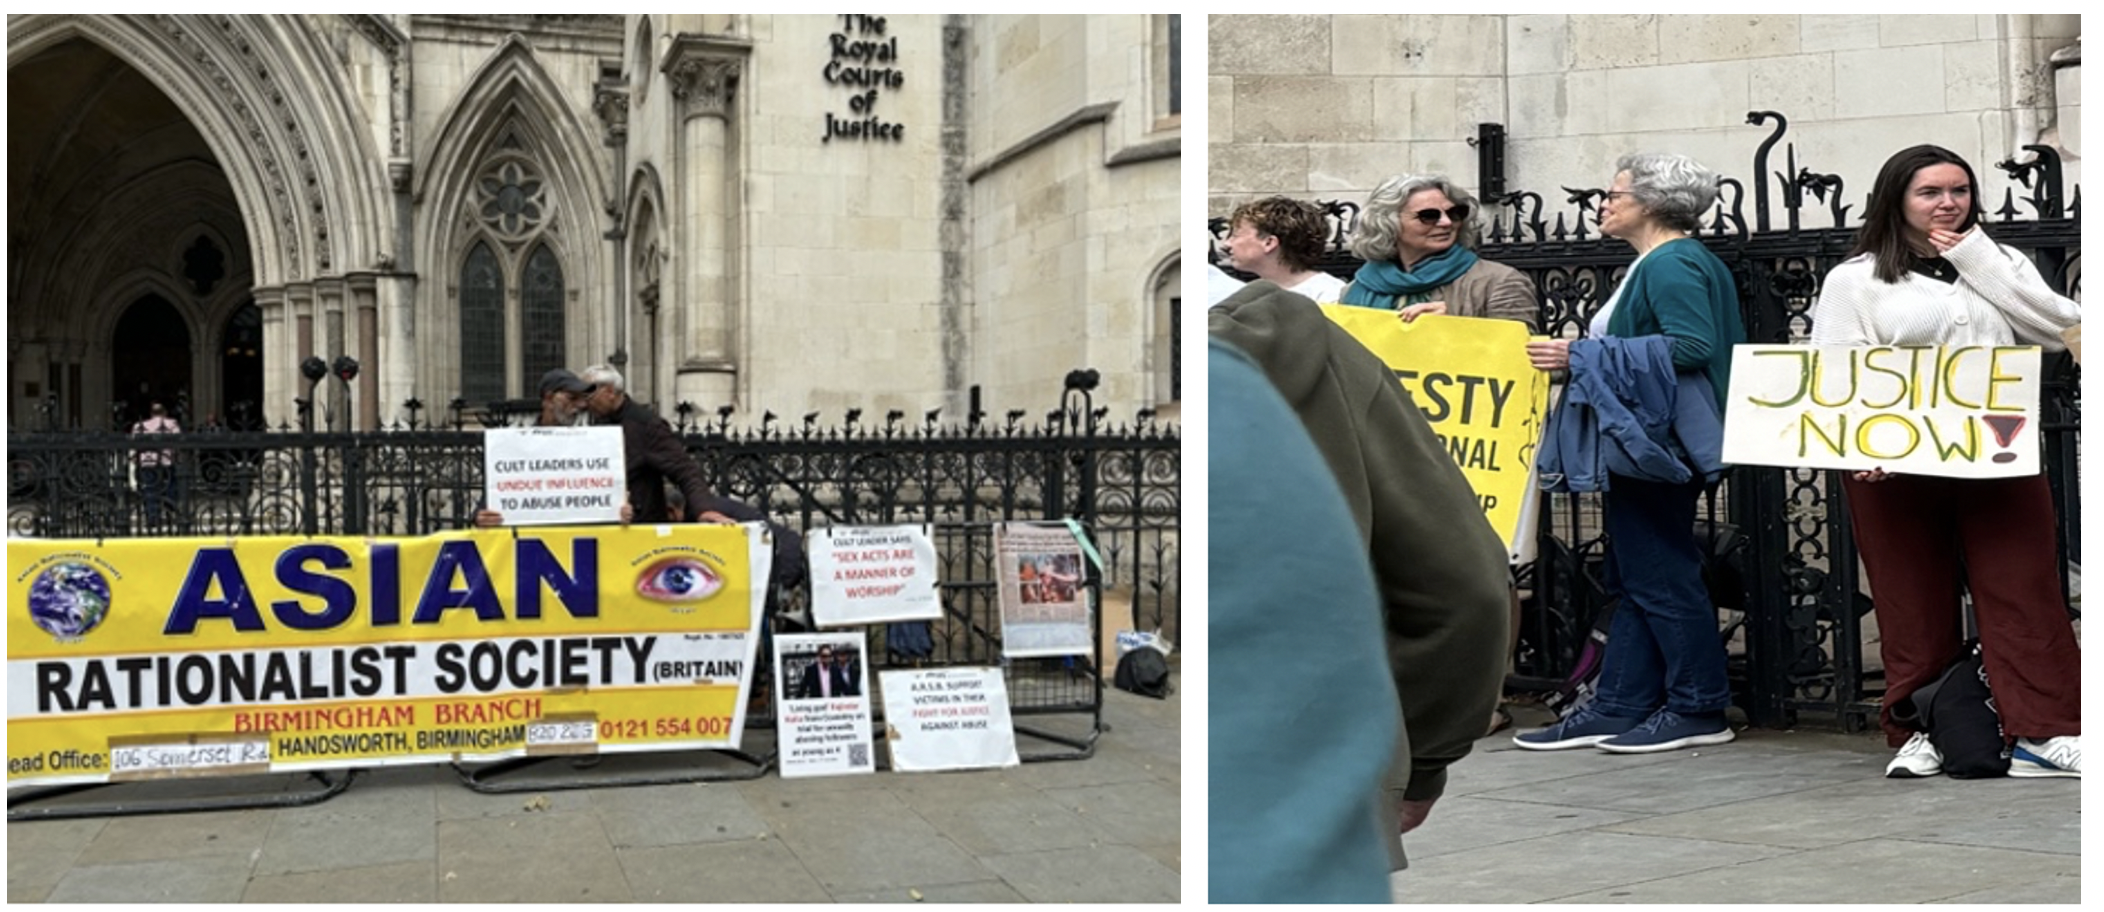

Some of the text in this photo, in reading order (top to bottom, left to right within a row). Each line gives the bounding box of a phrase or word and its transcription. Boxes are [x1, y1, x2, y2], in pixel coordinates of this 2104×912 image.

[837, 14, 887, 35] The
[828, 33, 897, 66] Royal
[823, 60, 904, 89] Courts
[849, 89, 878, 114] of
[821, 112, 904, 143] Justice
[1747, 344, 2033, 411] JUSTICE
[1797, 412, 2027, 464] NOW!
[494, 457, 610, 473] CULT LEADERS USE
[496, 476, 614, 493] UNDUE INFLUENCE
[499, 494, 612, 511] TO ABUSE PEOPLE
[833, 538, 855, 548] CULT
[861, 549, 890, 561] ACTS
[892, 548, 915, 560] ARE
[163, 537, 600, 635] ASIAN
[834, 566, 915, 581] A MANNER OF
[37, 644, 416, 712] RATIONALIST
[434, 636, 658, 694] SOCIETY
[235, 698, 542, 734] BIRMINGHAM BRANCH
[600, 719, 649, 740] 0121
[655, 716, 691, 737] 554
[416, 725, 526, 750] BIRMINGHAM
[7, 750, 108, 773] ead Office:
